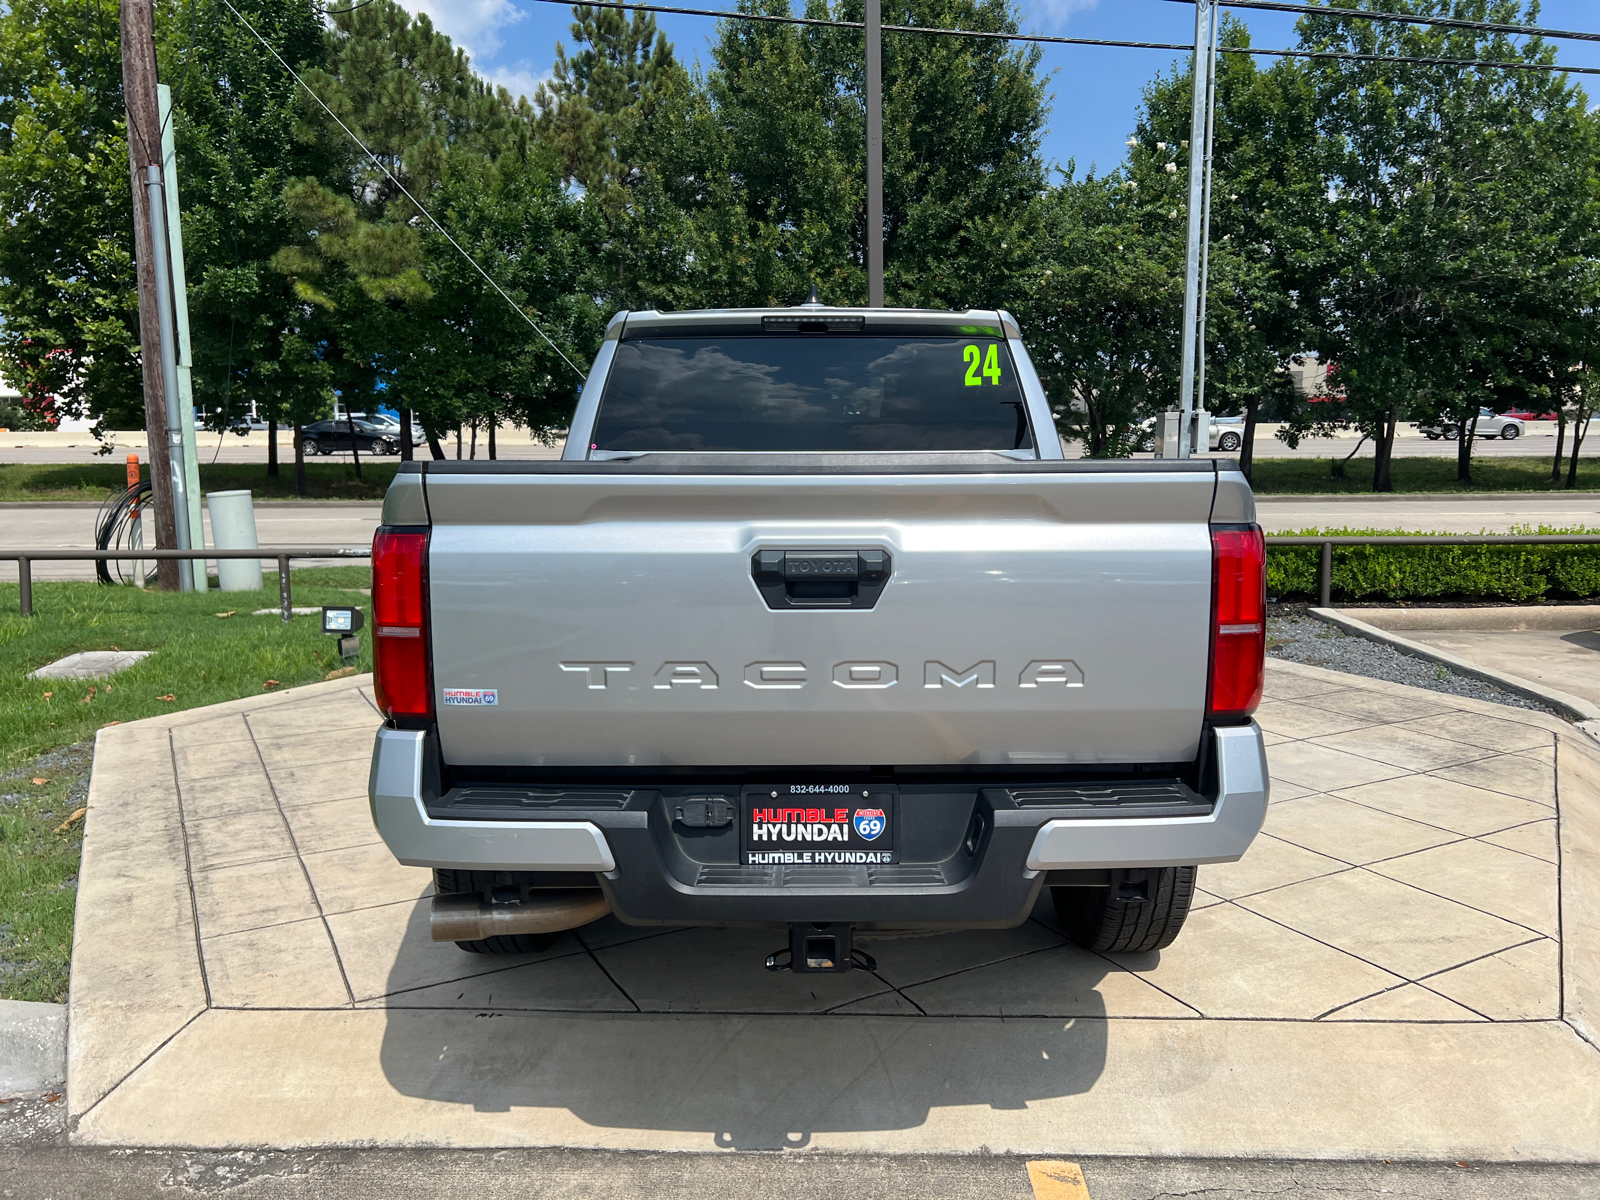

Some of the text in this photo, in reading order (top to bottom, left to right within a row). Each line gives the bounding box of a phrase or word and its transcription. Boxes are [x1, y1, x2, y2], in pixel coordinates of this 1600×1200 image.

[964, 344, 1001, 386] 24
[789, 560, 855, 572] TOYOTA
[558, 660, 1085, 689] TACOMA
[790, 785, 850, 794] 832-644-4000
[753, 808, 849, 823] HUMBLE
[752, 824, 849, 841] HYUNDAI
[859, 820, 881, 835] 69
[748, 853, 812, 864] HUMBLE
[815, 853, 881, 863] HYUNDAI
